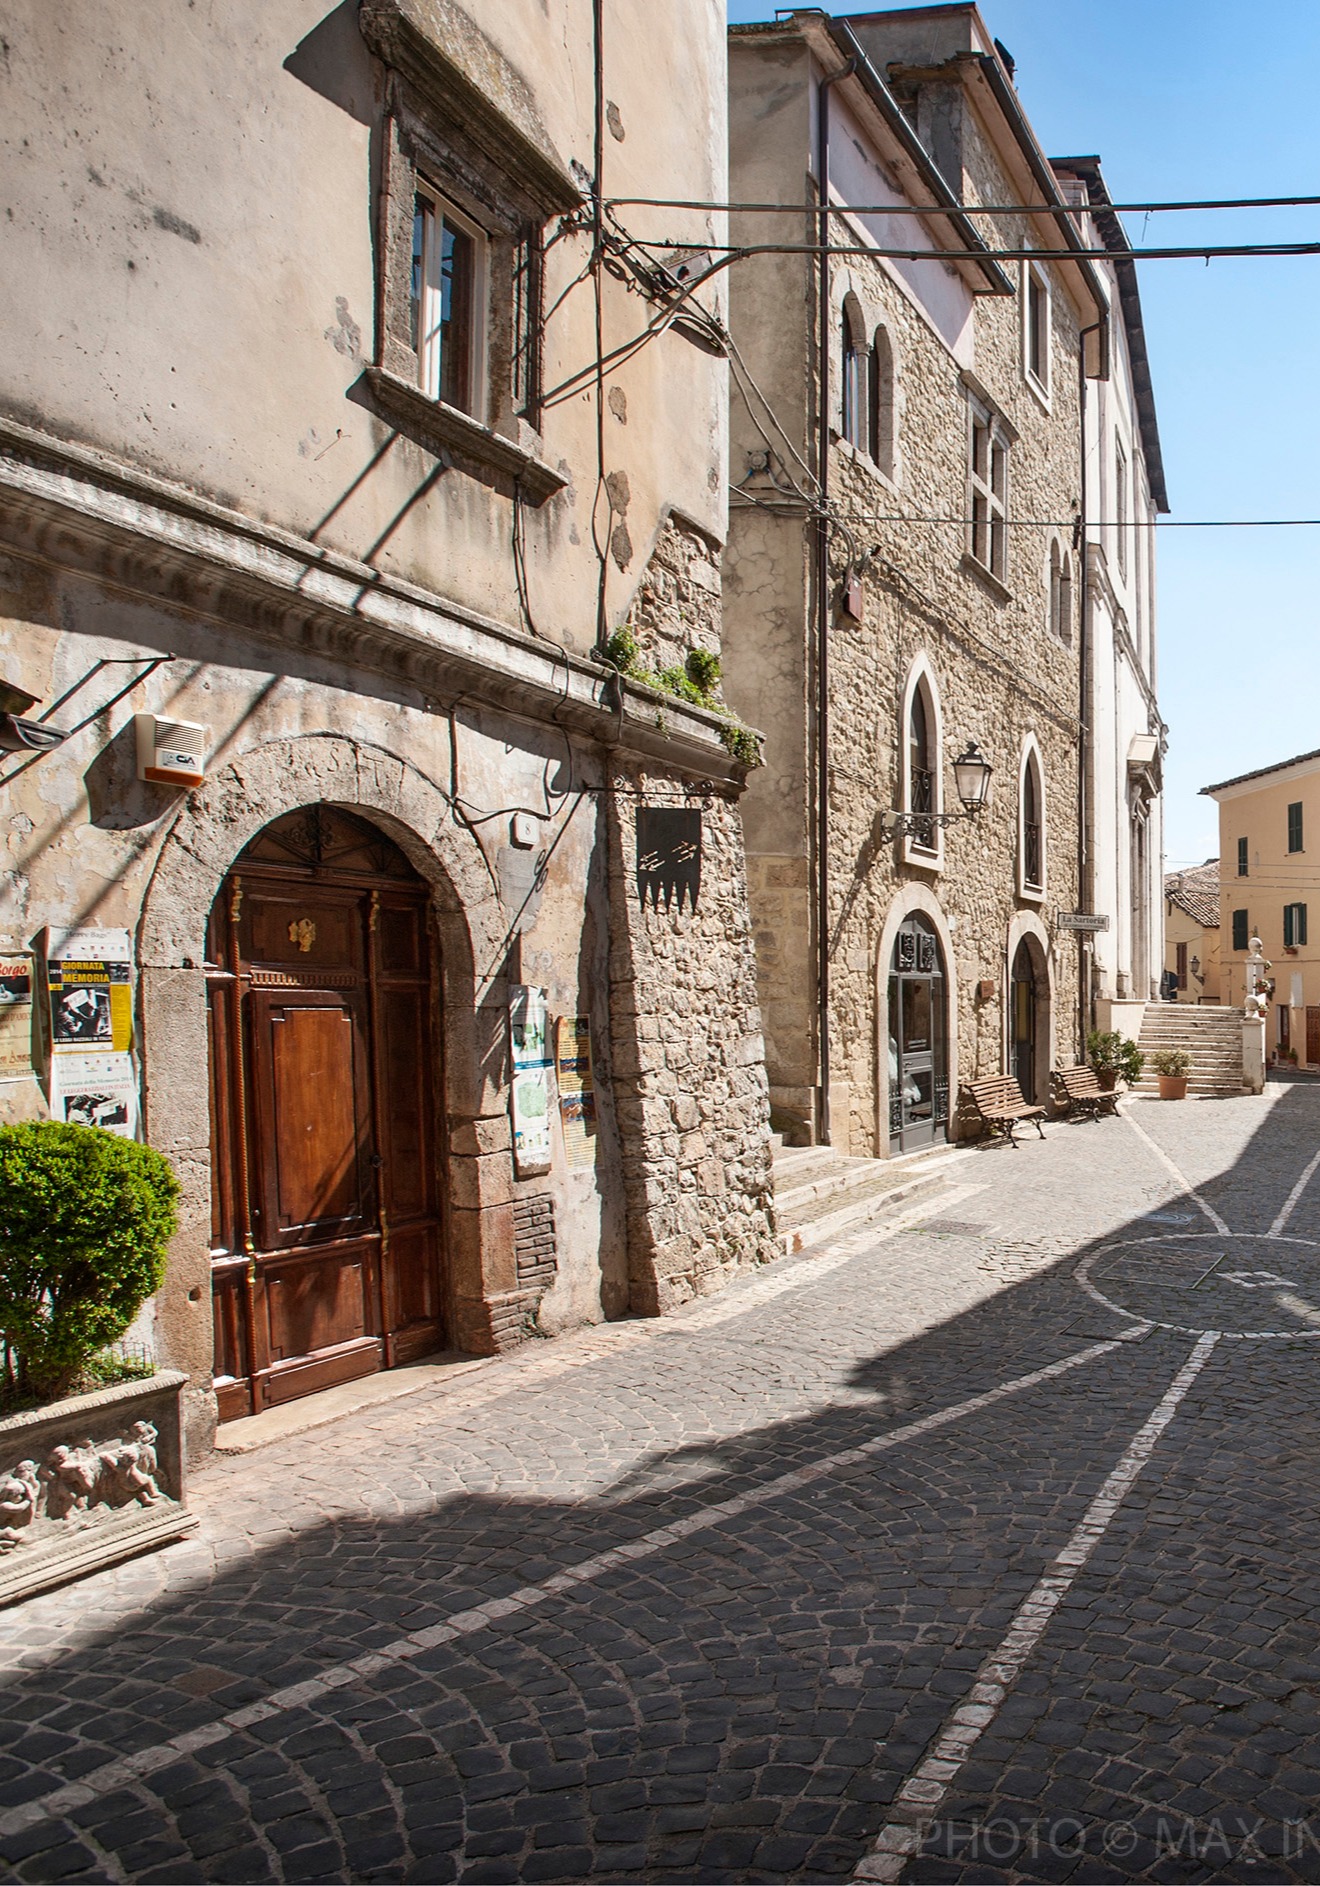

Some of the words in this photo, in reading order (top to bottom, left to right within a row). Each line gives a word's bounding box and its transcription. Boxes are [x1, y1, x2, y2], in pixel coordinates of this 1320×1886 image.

[1062, 915, 1072, 923] La
[1073, 916, 1106, 924] Sartoria
[62, 961, 105, 971] GIORNATA
[0, 963, 28, 980] orgo
[63, 973, 111, 983] MEMORIA
